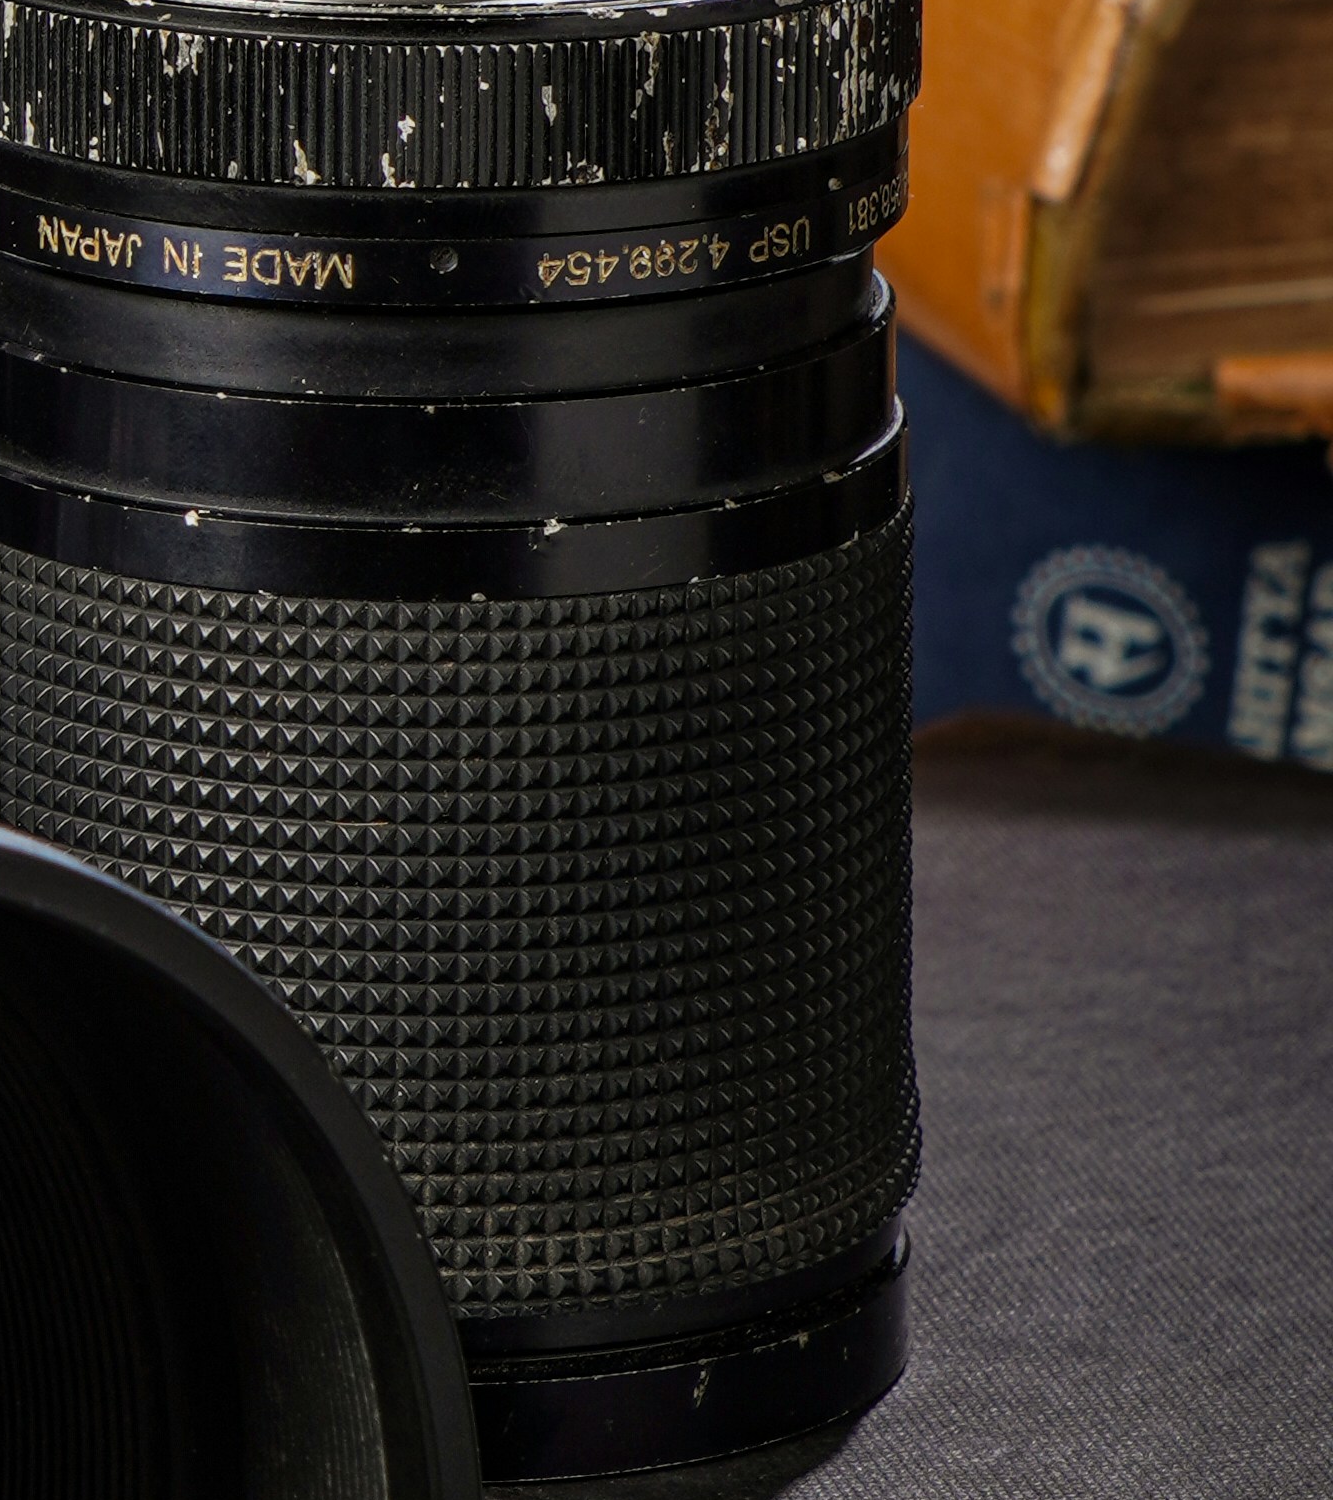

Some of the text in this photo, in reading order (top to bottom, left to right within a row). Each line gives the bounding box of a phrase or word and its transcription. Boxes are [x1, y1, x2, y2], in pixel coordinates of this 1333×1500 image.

[37, 214, 353, 290] MADE IN JAPAN
[748, 215, 811, 263] USP
